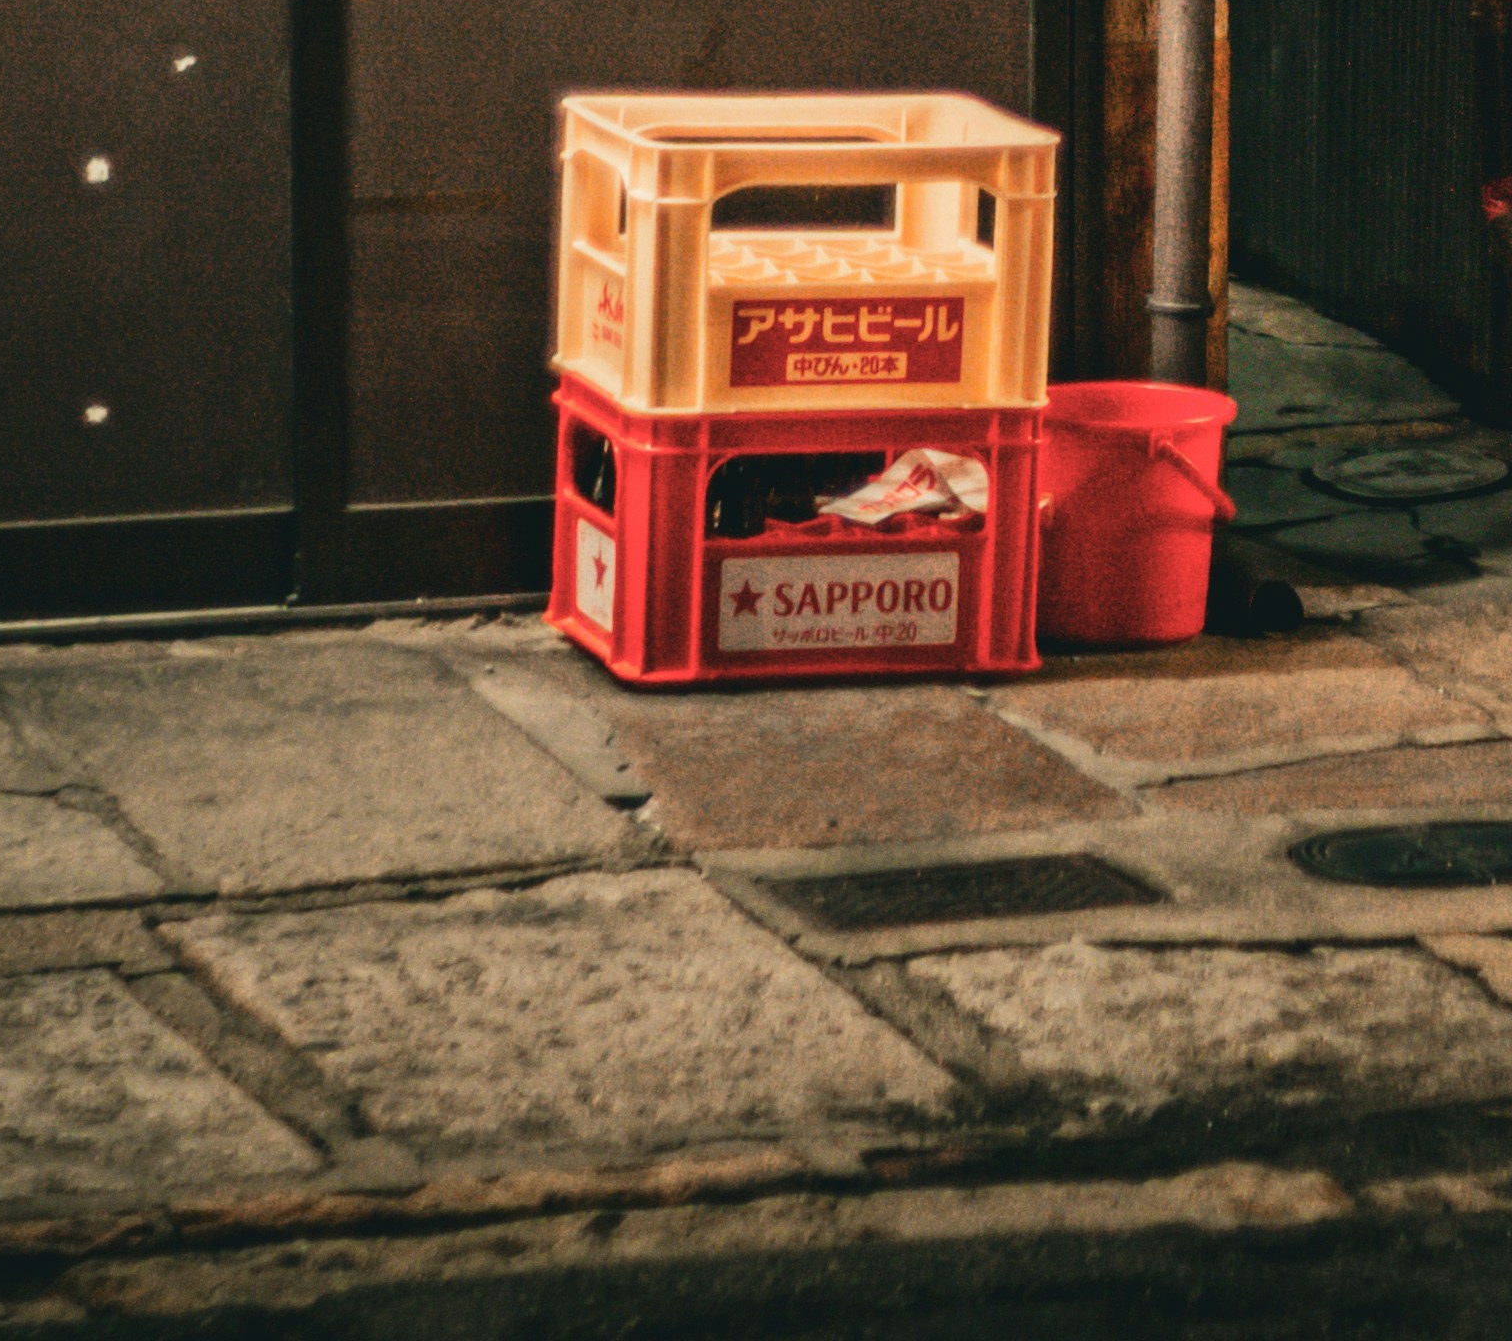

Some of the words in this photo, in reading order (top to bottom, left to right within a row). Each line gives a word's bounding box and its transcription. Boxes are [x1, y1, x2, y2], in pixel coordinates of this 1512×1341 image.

[736, 304, 960, 345] アサヒビール
[772, 577, 952, 617] SAPPORO
